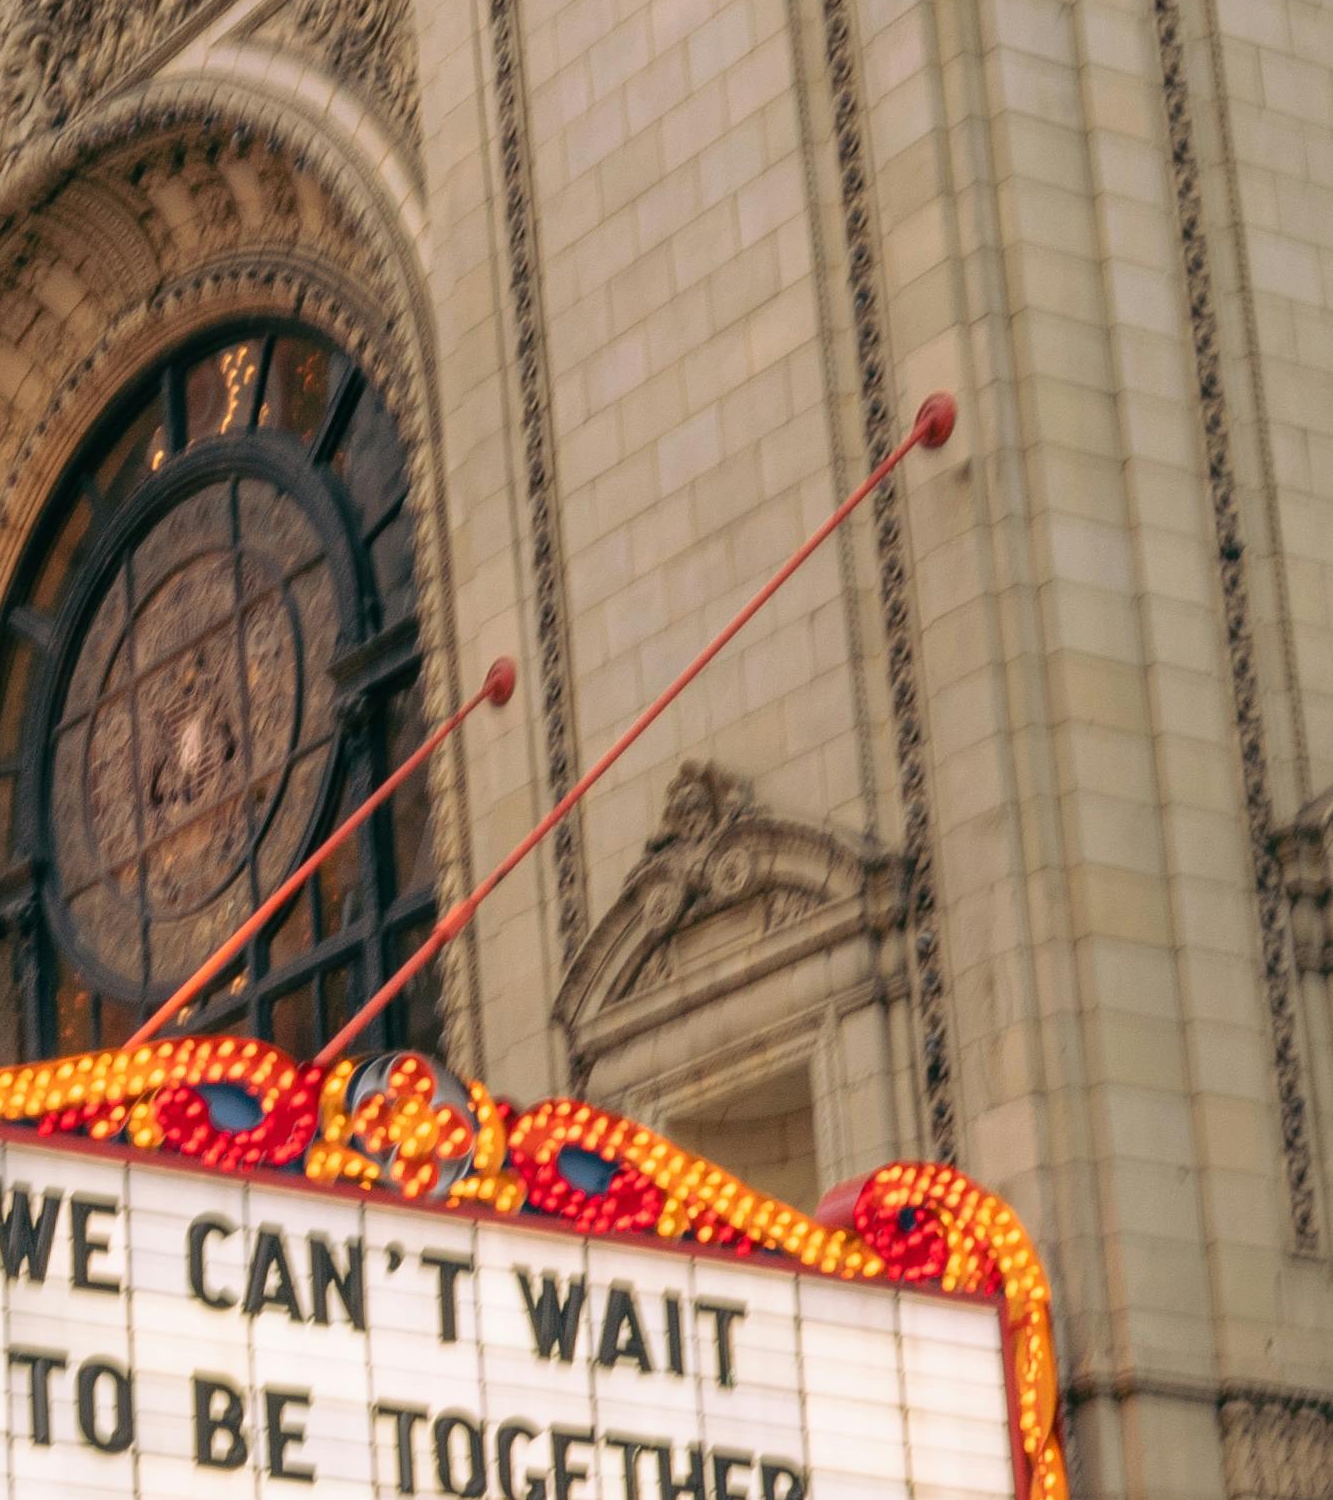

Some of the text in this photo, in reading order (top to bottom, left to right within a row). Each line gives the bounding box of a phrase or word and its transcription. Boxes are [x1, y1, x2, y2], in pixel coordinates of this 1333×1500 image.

[185, 1210, 475, 1344] CAN'T
[515, 1264, 747, 1390] WAIT
[7, 1350, 133, 1455] TO
[191, 1374, 315, 1483] BE
